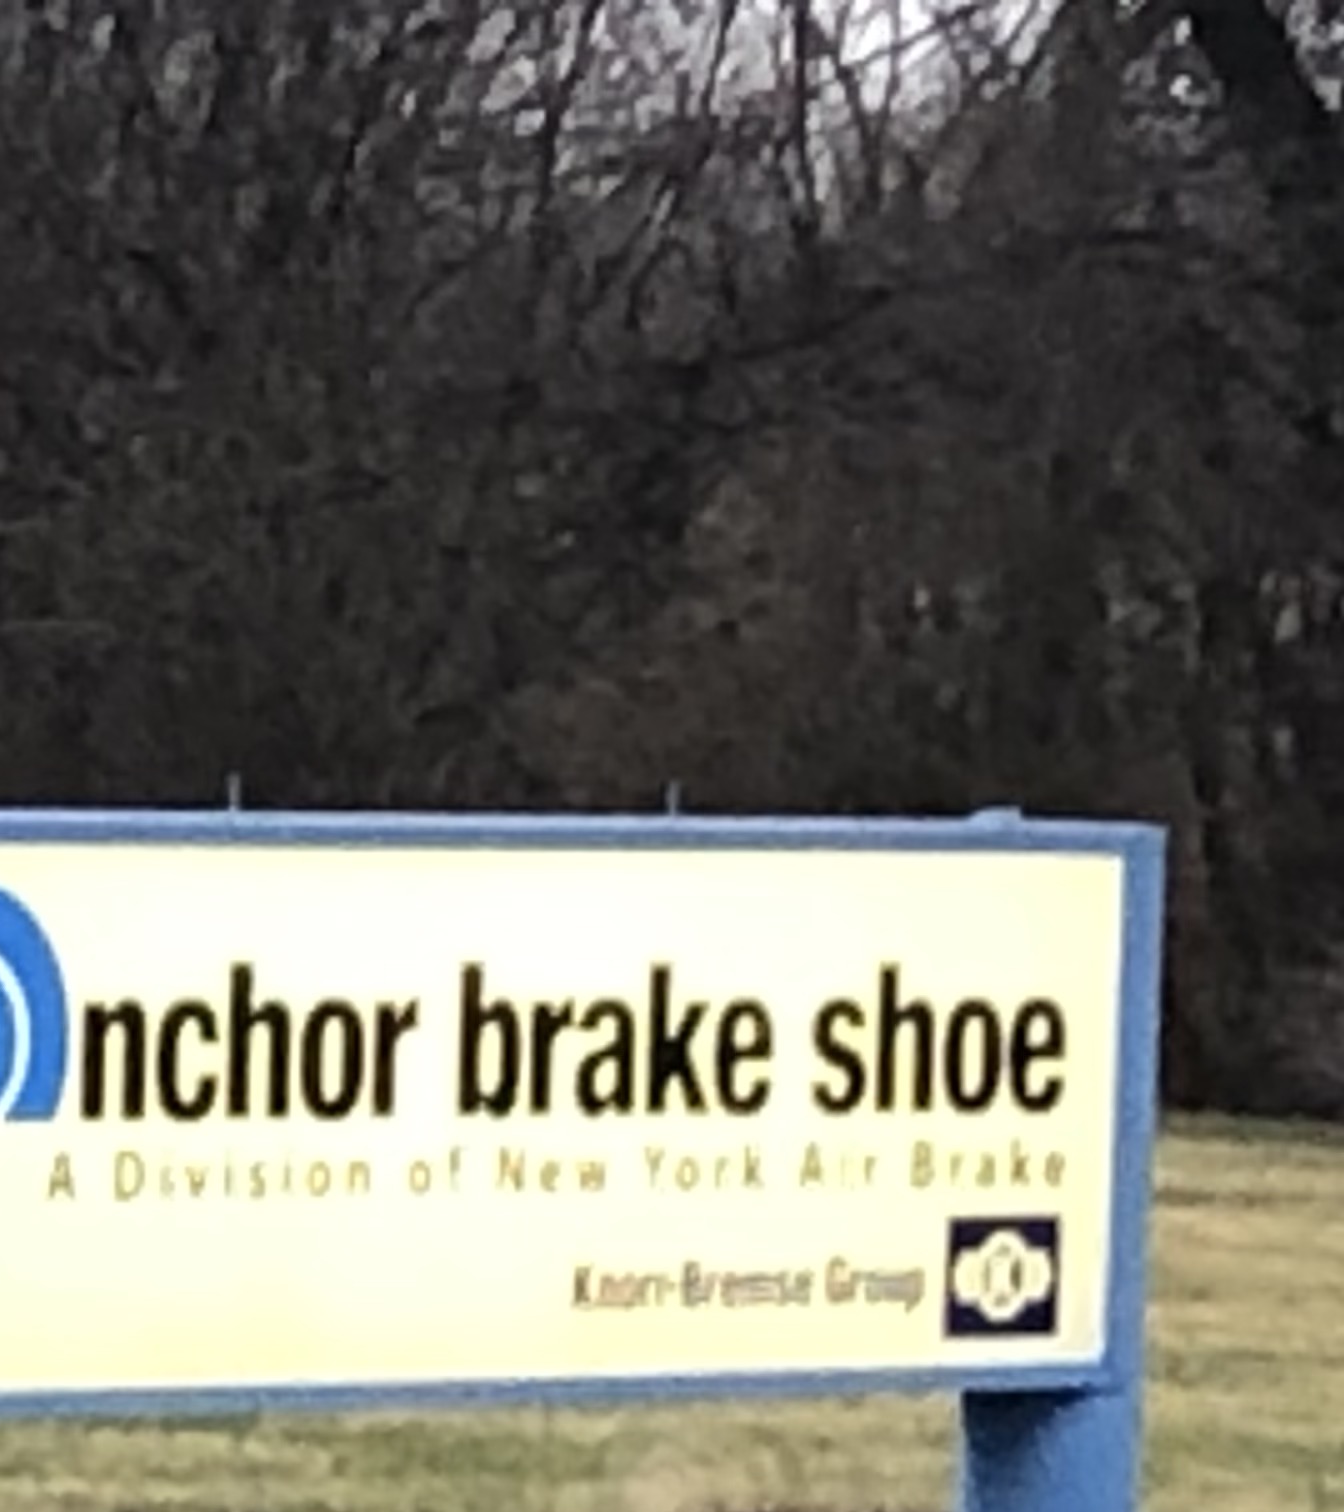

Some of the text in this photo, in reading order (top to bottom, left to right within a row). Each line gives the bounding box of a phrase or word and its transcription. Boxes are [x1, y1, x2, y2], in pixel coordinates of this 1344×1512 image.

[457, 962, 773, 1119] brake
[811, 963, 1067, 1114] shoe
[47, 1153, 76, 1201] A
[409, 1145, 466, 1195] of
[497, 1147, 607, 1193] New
[644, 1145, 763, 1191] York
[908, 1138, 1066, 1190] Brake
[572, 1260, 814, 1309] Krr-Brse
